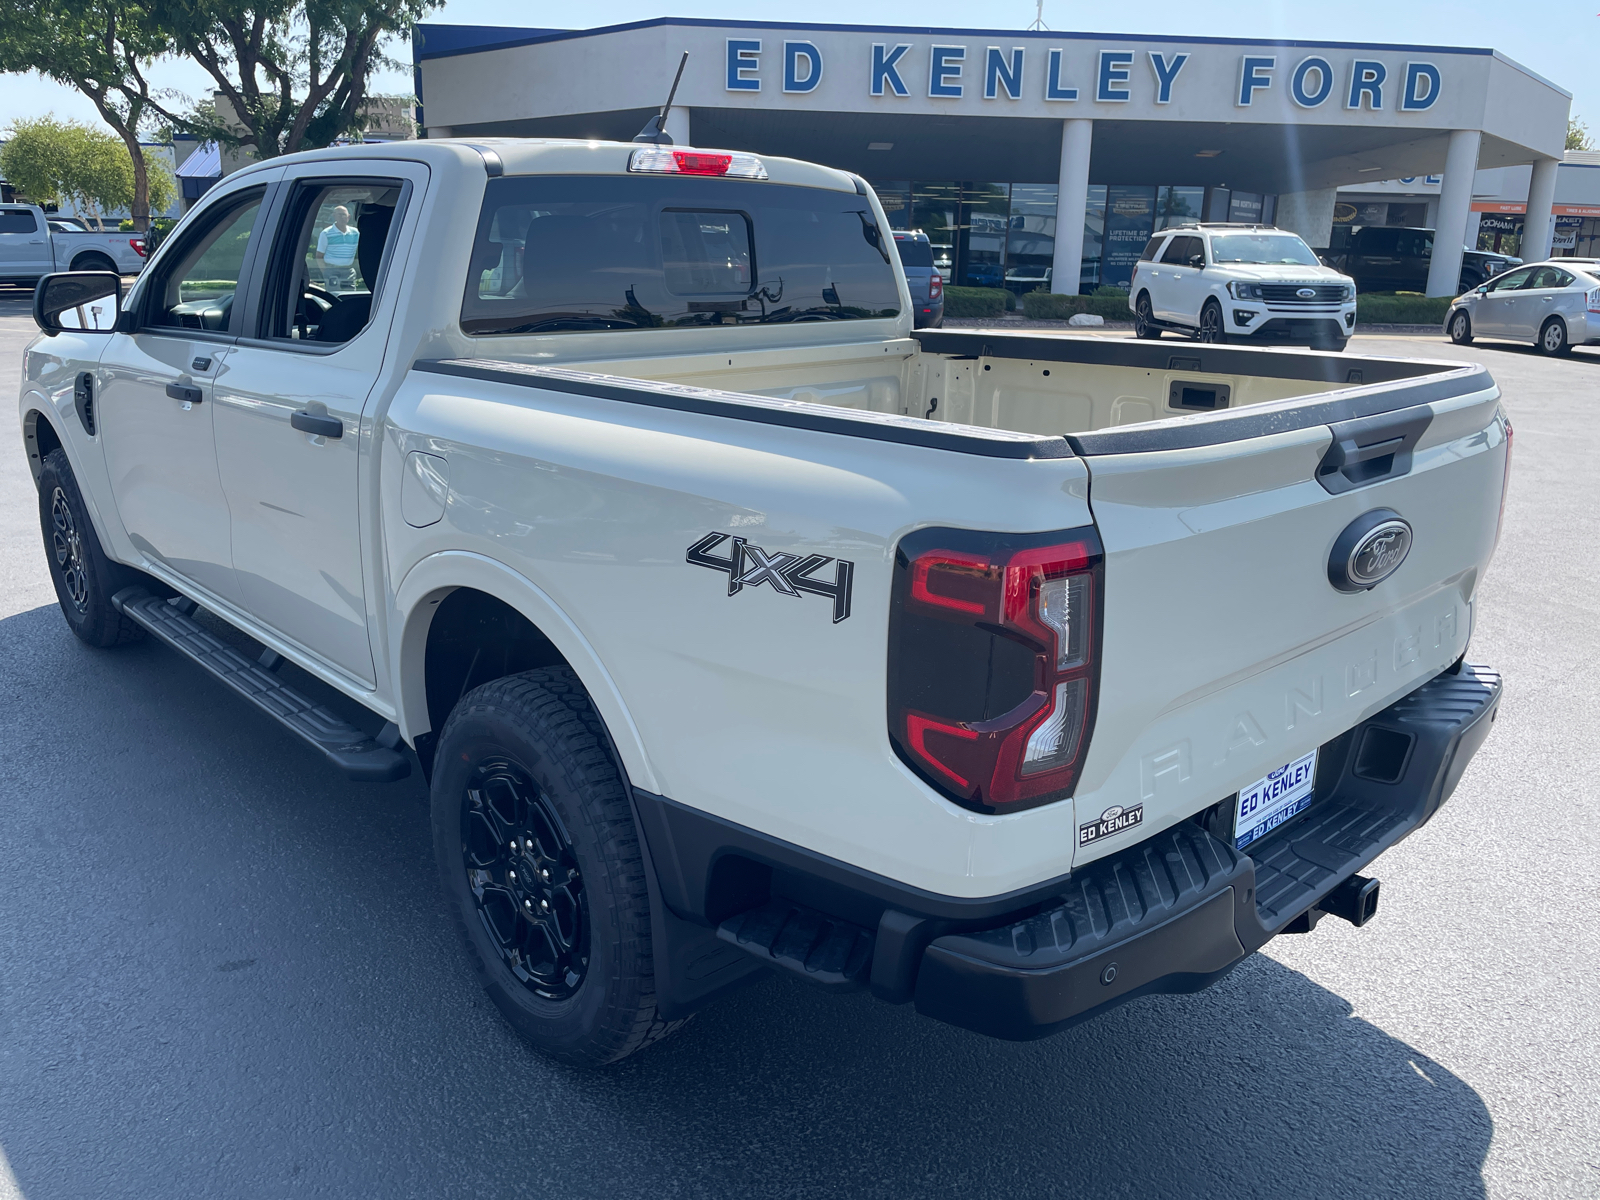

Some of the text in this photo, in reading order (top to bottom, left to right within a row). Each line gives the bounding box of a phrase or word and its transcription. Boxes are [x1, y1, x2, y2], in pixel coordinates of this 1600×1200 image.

[725, 37, 1442, 111] ED KENLEY FORD
[1366, 533, 1403, 573] Ford
[1139, 604, 1458, 800] RANGER
[1240, 792, 1258, 818] ED
[1262, 761, 1312, 805] KENLEY
[1080, 808, 1143, 842] ED KENLEY
[1105, 809, 1119, 819] Ford
[1252, 824, 1265, 841] ED
[1266, 802, 1299, 831] KENLEY
